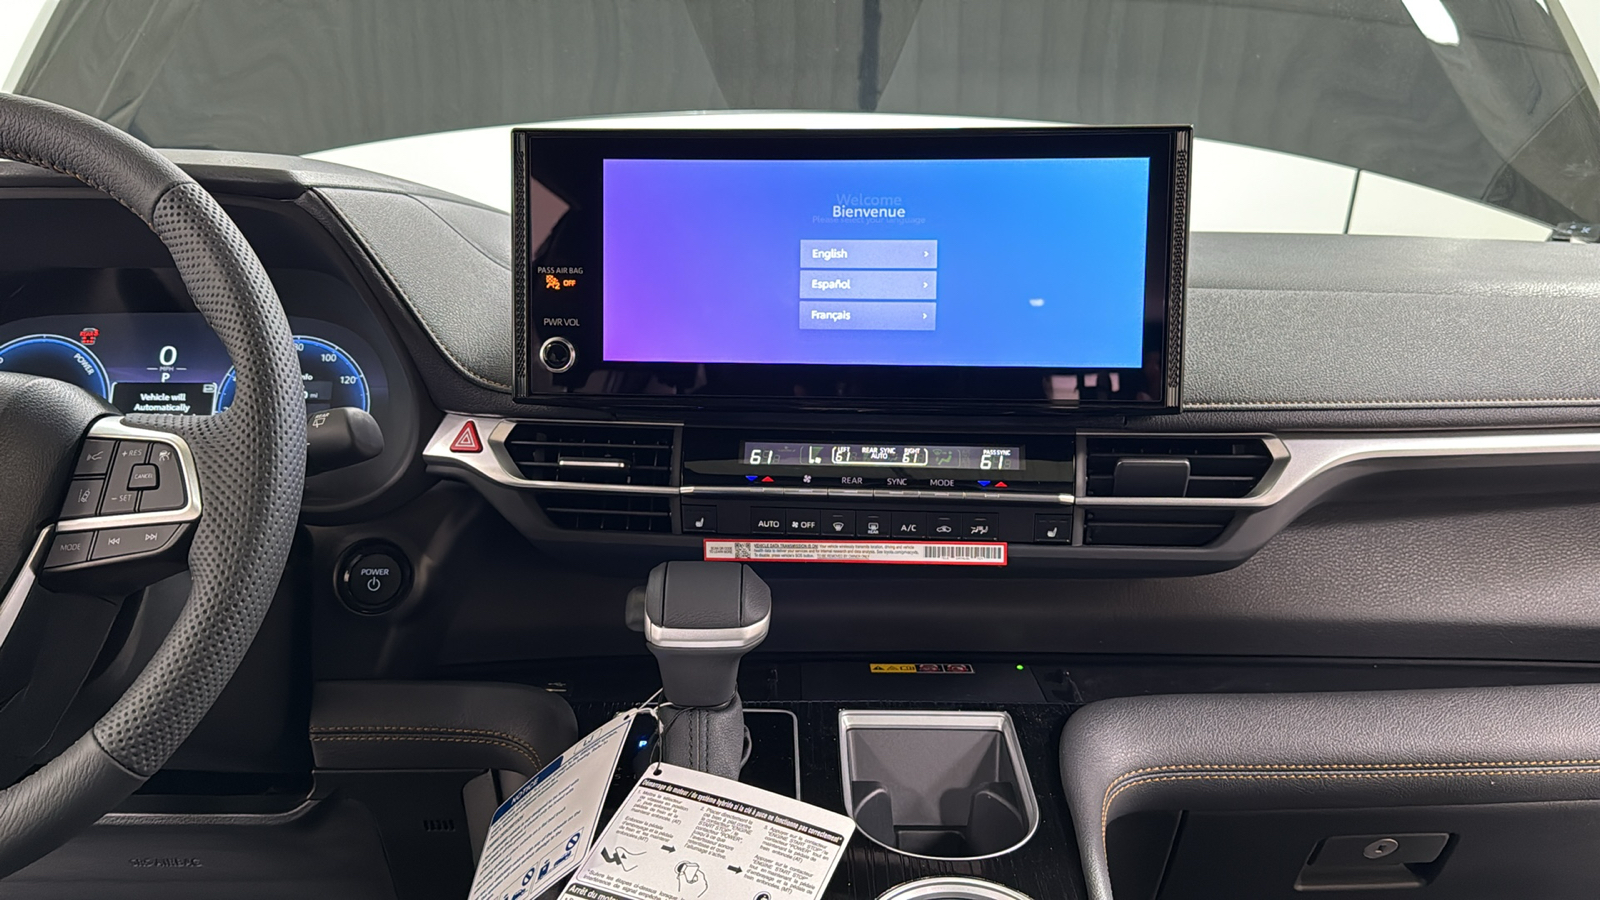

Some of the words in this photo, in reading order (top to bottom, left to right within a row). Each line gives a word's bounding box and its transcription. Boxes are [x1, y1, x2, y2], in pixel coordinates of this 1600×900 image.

[836, 193, 902, 206] Welcome
[832, 205, 906, 218] Bienvenue
[812, 248, 848, 261] English
[811, 279, 851, 291] Español
[811, 310, 851, 322] Français
[544, 318, 562, 326] PWR
[564, 318, 580, 326] VOL
[159, 345, 178, 366] 0
[321, 353, 338, 362] 100
[73, 353, 95, 376] POWER
[161, 372, 170, 383] P
[340, 376, 357, 385] 120
[140, 392, 170, 401] Vehicle
[171, 393, 186, 401] will
[134, 403, 191, 413] Automatically
[750, 450, 773, 465] 61
[980, 454, 1004, 470] 61
[887, 478, 908, 486] SYNC
[930, 479, 954, 487] MODE
[758, 520, 780, 528] AUTO
[800, 521, 816, 529] OFF
[901, 524, 917, 532] A/C
[60, 543, 81, 552] MODE
[569, 885, 588, 895] Arrêt
